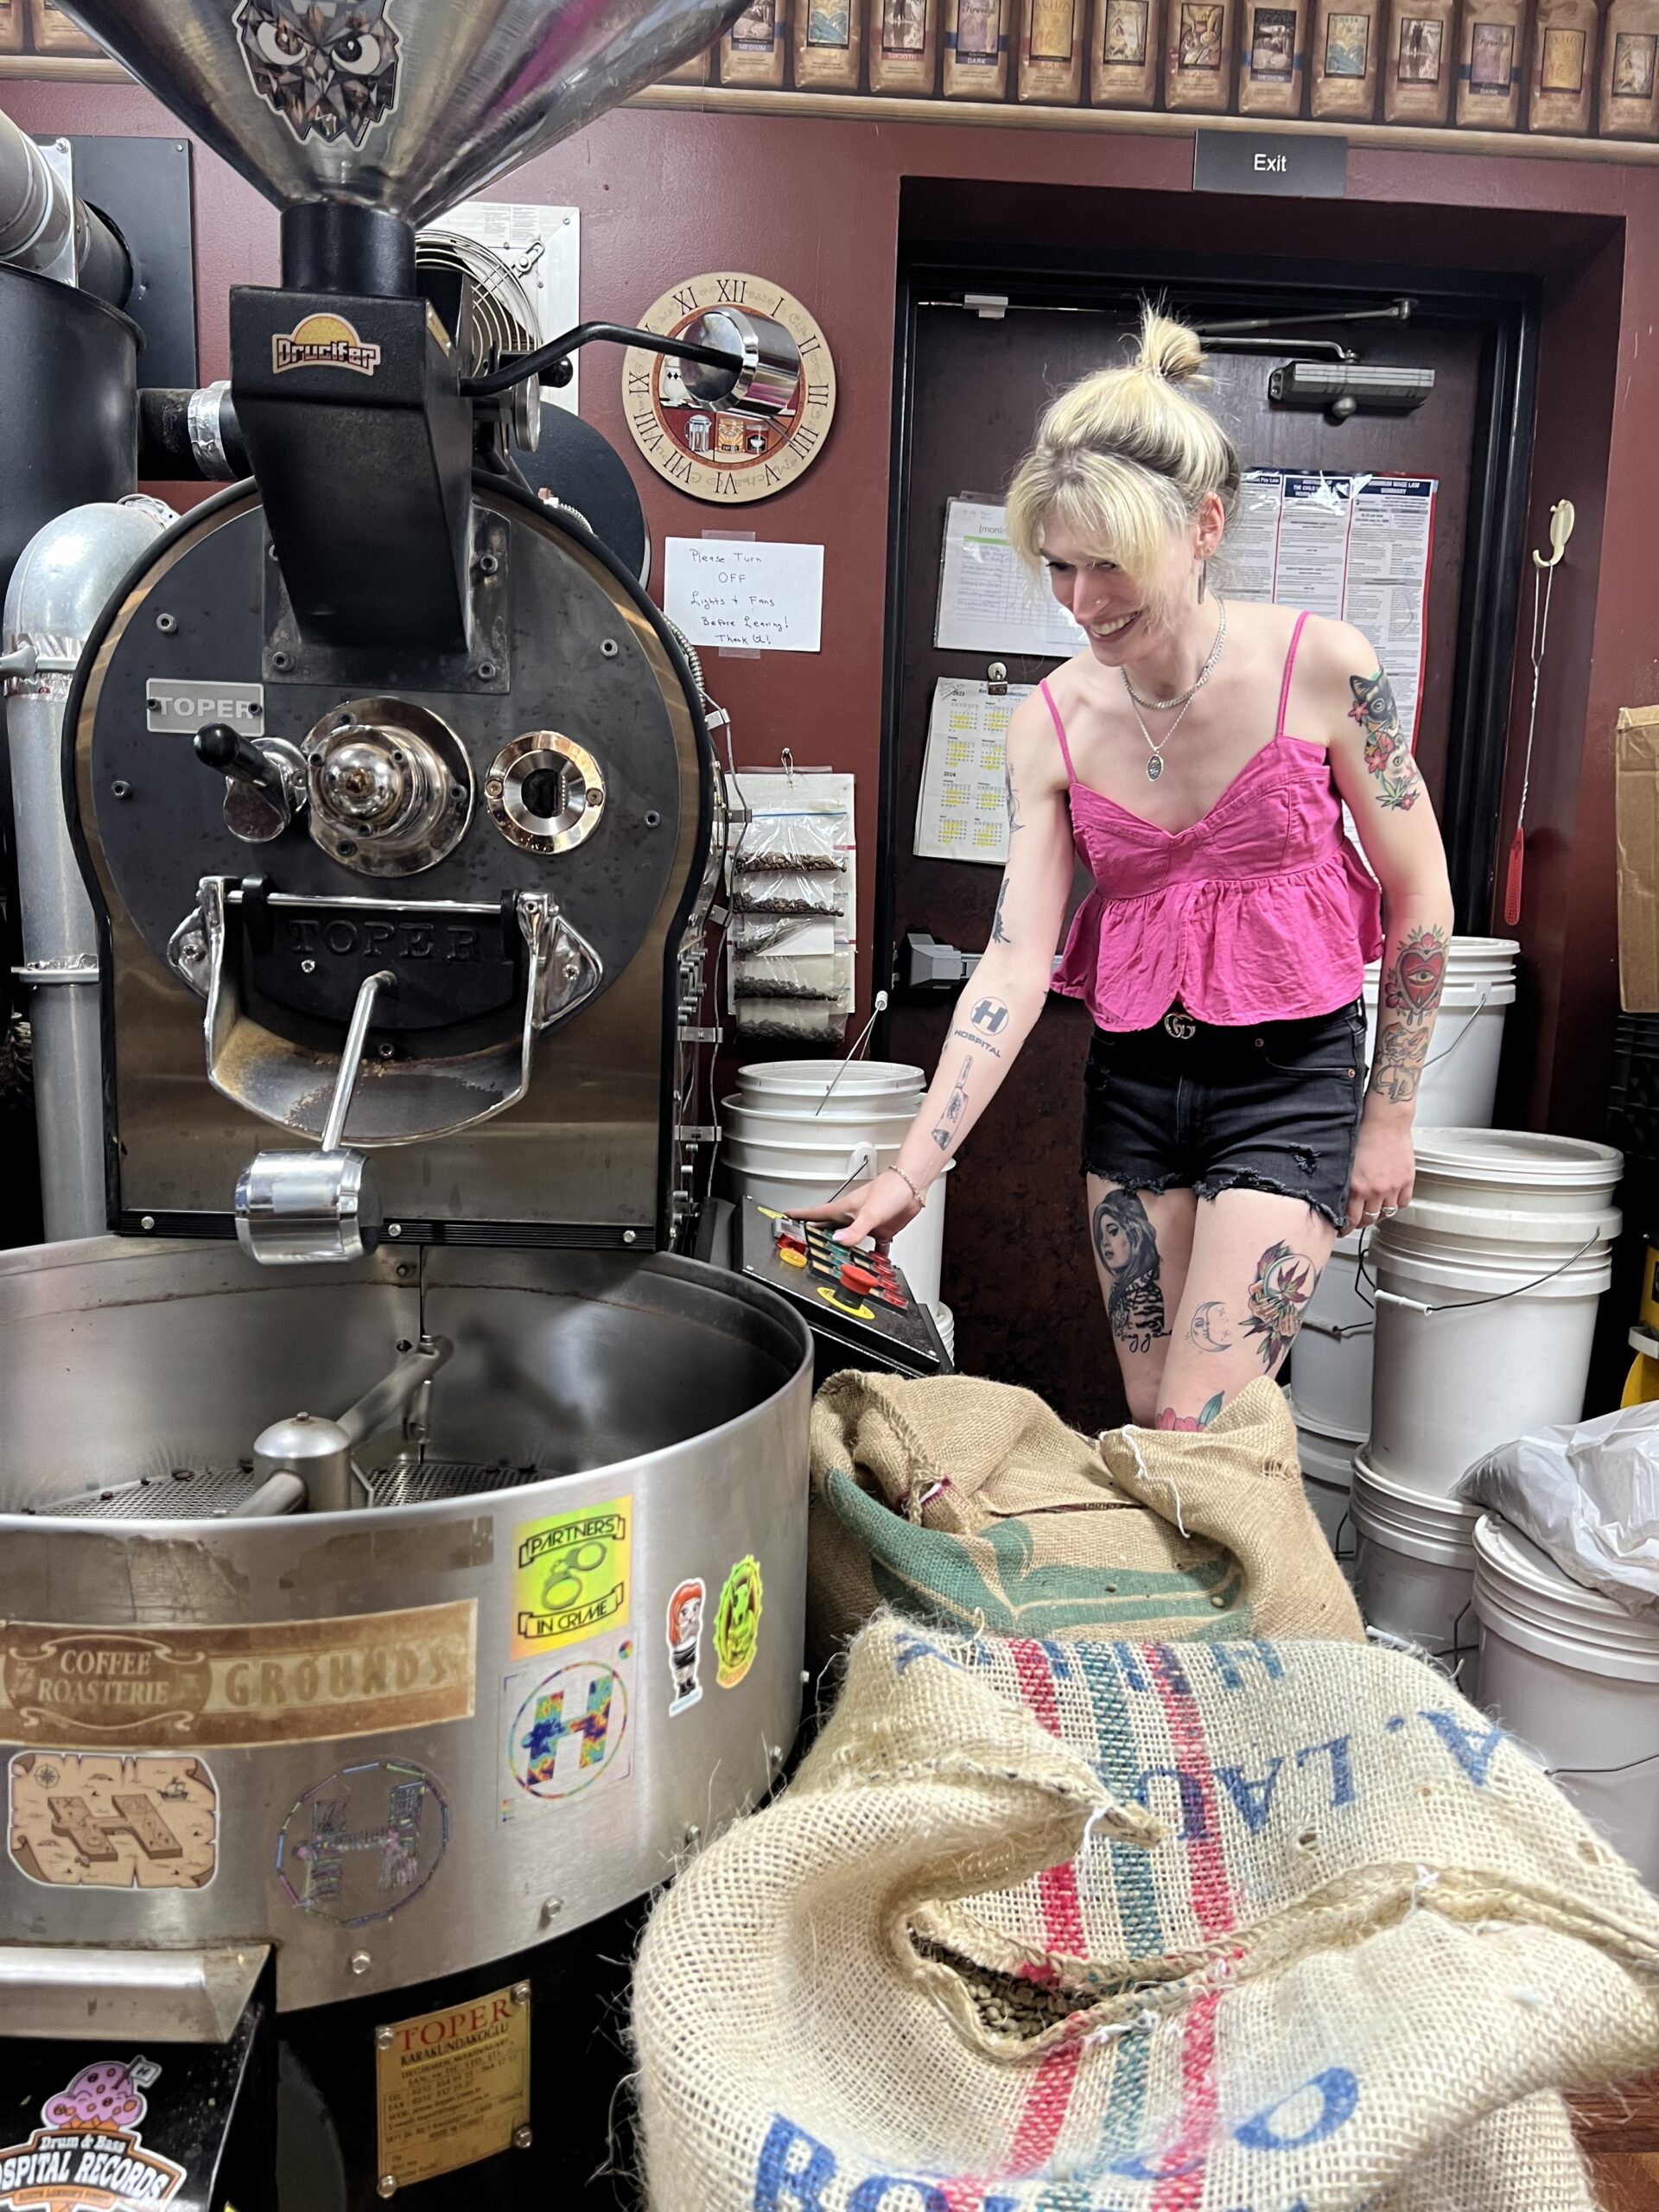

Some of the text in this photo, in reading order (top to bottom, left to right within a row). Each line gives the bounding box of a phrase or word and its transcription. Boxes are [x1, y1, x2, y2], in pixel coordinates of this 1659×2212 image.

[1254, 153, 1287, 173] Exit
[716, 279, 747, 303] XII
[276, 338, 377, 370] Drucifer
[808, 384, 829, 407] III
[714, 472, 739, 494] VI
[690, 548, 762, 563] Please Turn
[718, 572, 746, 583] OFF
[690, 591, 725, 610] Lights
[749, 596, 775, 607] Fans
[701, 615, 789, 632] Before Leaving!
[715, 634, 749, 645] Thank
[152, 696, 253, 720] TOPER
[289, 920, 480, 961] TOPER
[954, 1028, 1001, 1058] HOSPITAL
[531, 1517, 614, 1555] PARTNERS
[537, 1599, 607, 1635] IN CRIME
[60, 1649, 152, 1675] COFFEE
[225, 1648, 450, 1707] GROUNDS
[37, 1678, 169, 1706] ROASTERIE
[395, 1999, 512, 2052] TOPER
[39, 2134, 127, 2154] Drum & Bass
[74, 2151, 171, 2201] RECORDS
